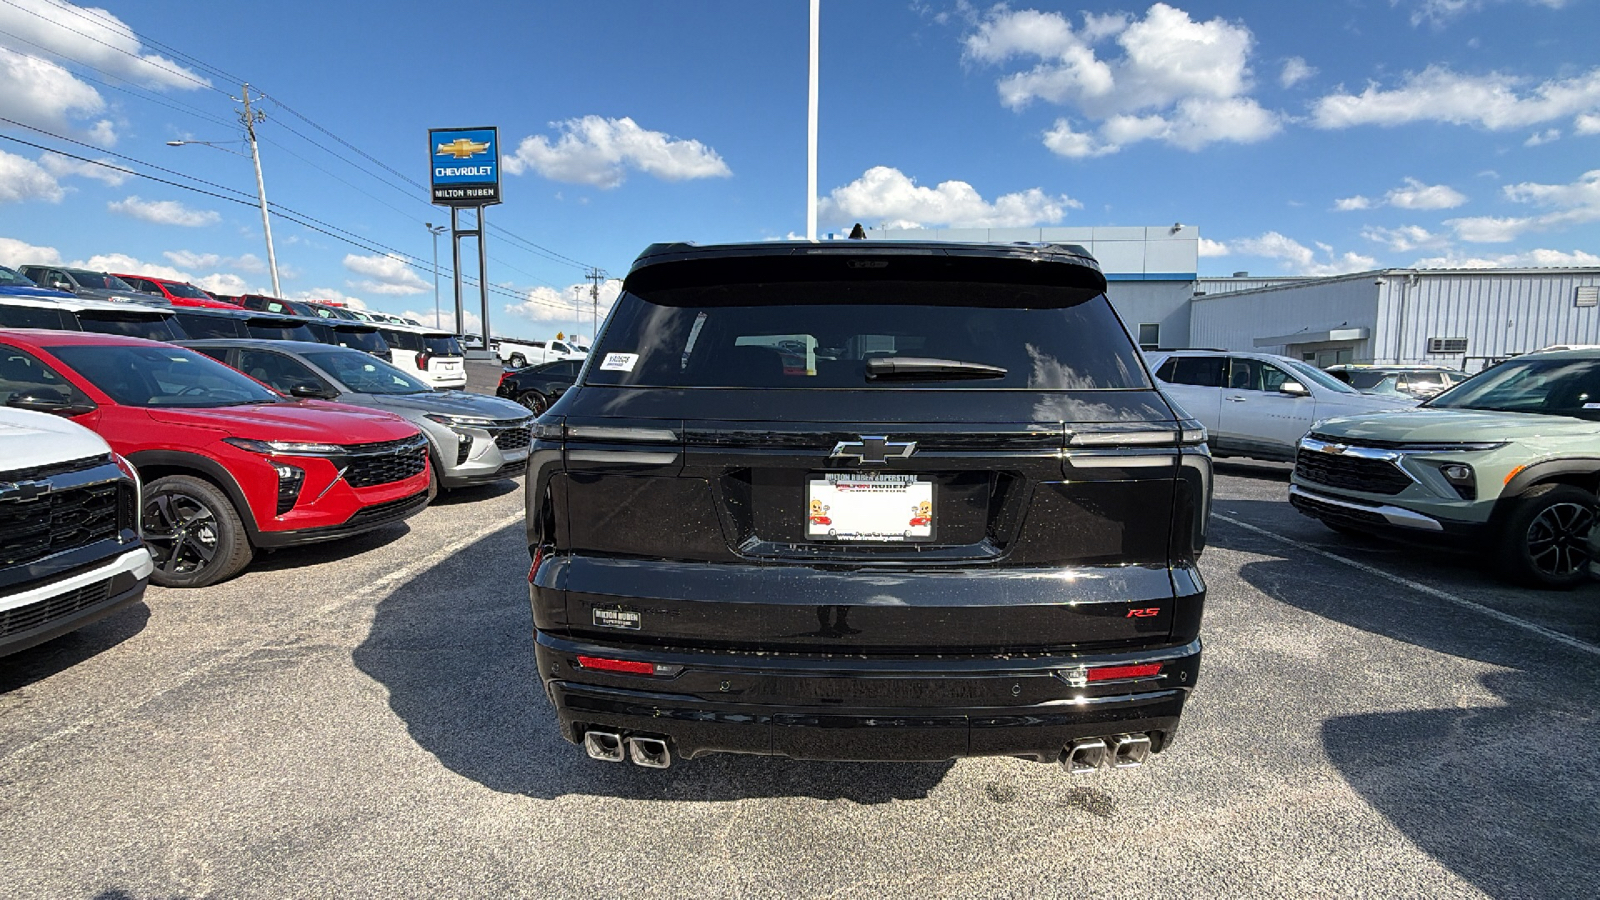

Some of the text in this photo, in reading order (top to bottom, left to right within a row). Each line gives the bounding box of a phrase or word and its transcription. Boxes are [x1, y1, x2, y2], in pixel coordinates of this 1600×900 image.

[435, 166, 492, 177] CHEVROLET
[435, 188, 494, 198] MILTON RUBEN
[595, 610, 639, 622] MILTON RUBEN
[1126, 607, 1160, 618] RS
